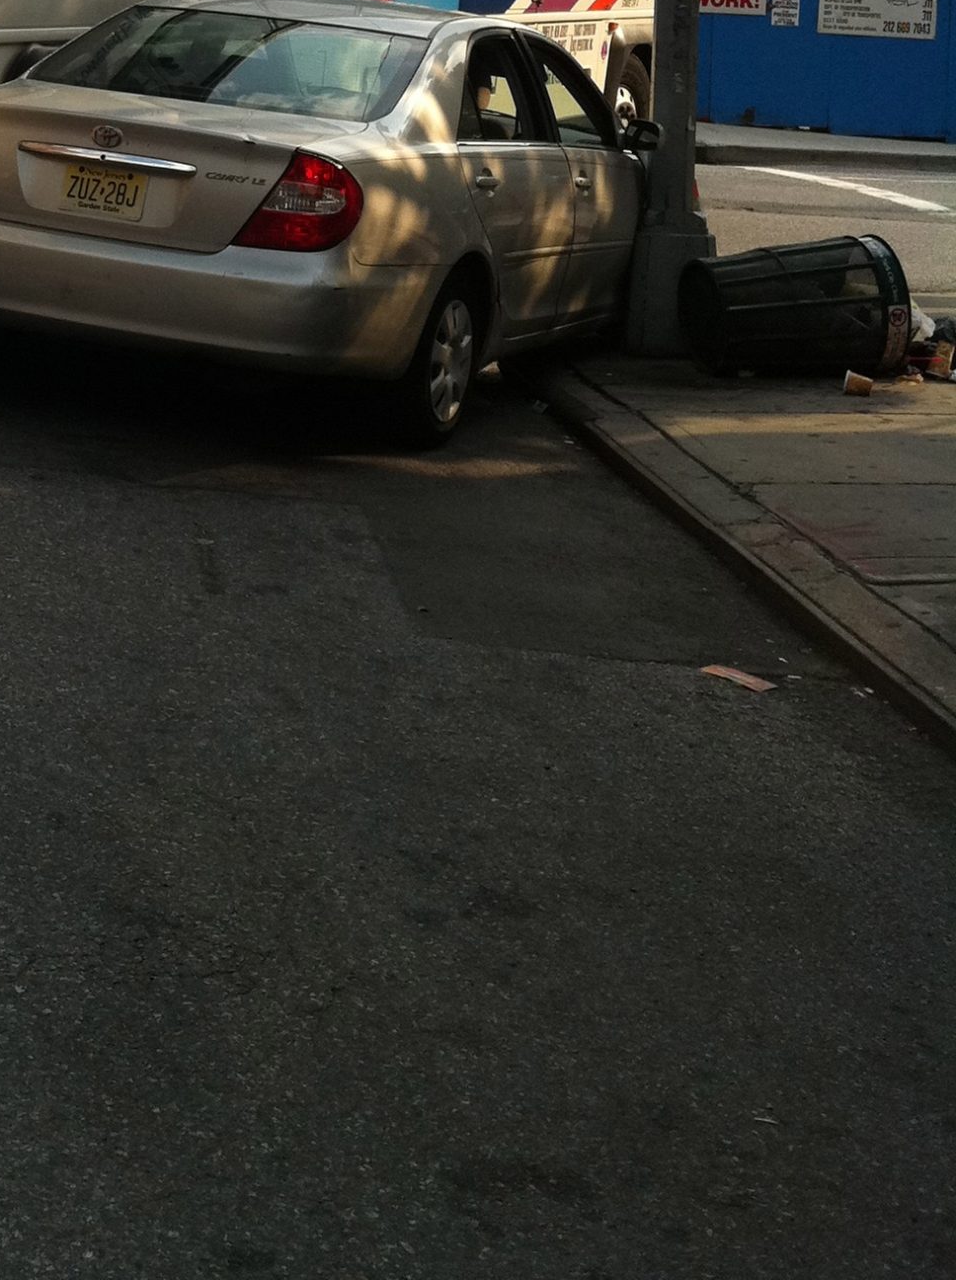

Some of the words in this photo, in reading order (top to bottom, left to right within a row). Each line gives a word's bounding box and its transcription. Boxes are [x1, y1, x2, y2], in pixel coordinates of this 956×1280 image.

[883, 21, 895, 33] 212
[78, 201, 101, 210] Garden
[102, 204, 120, 212] State
